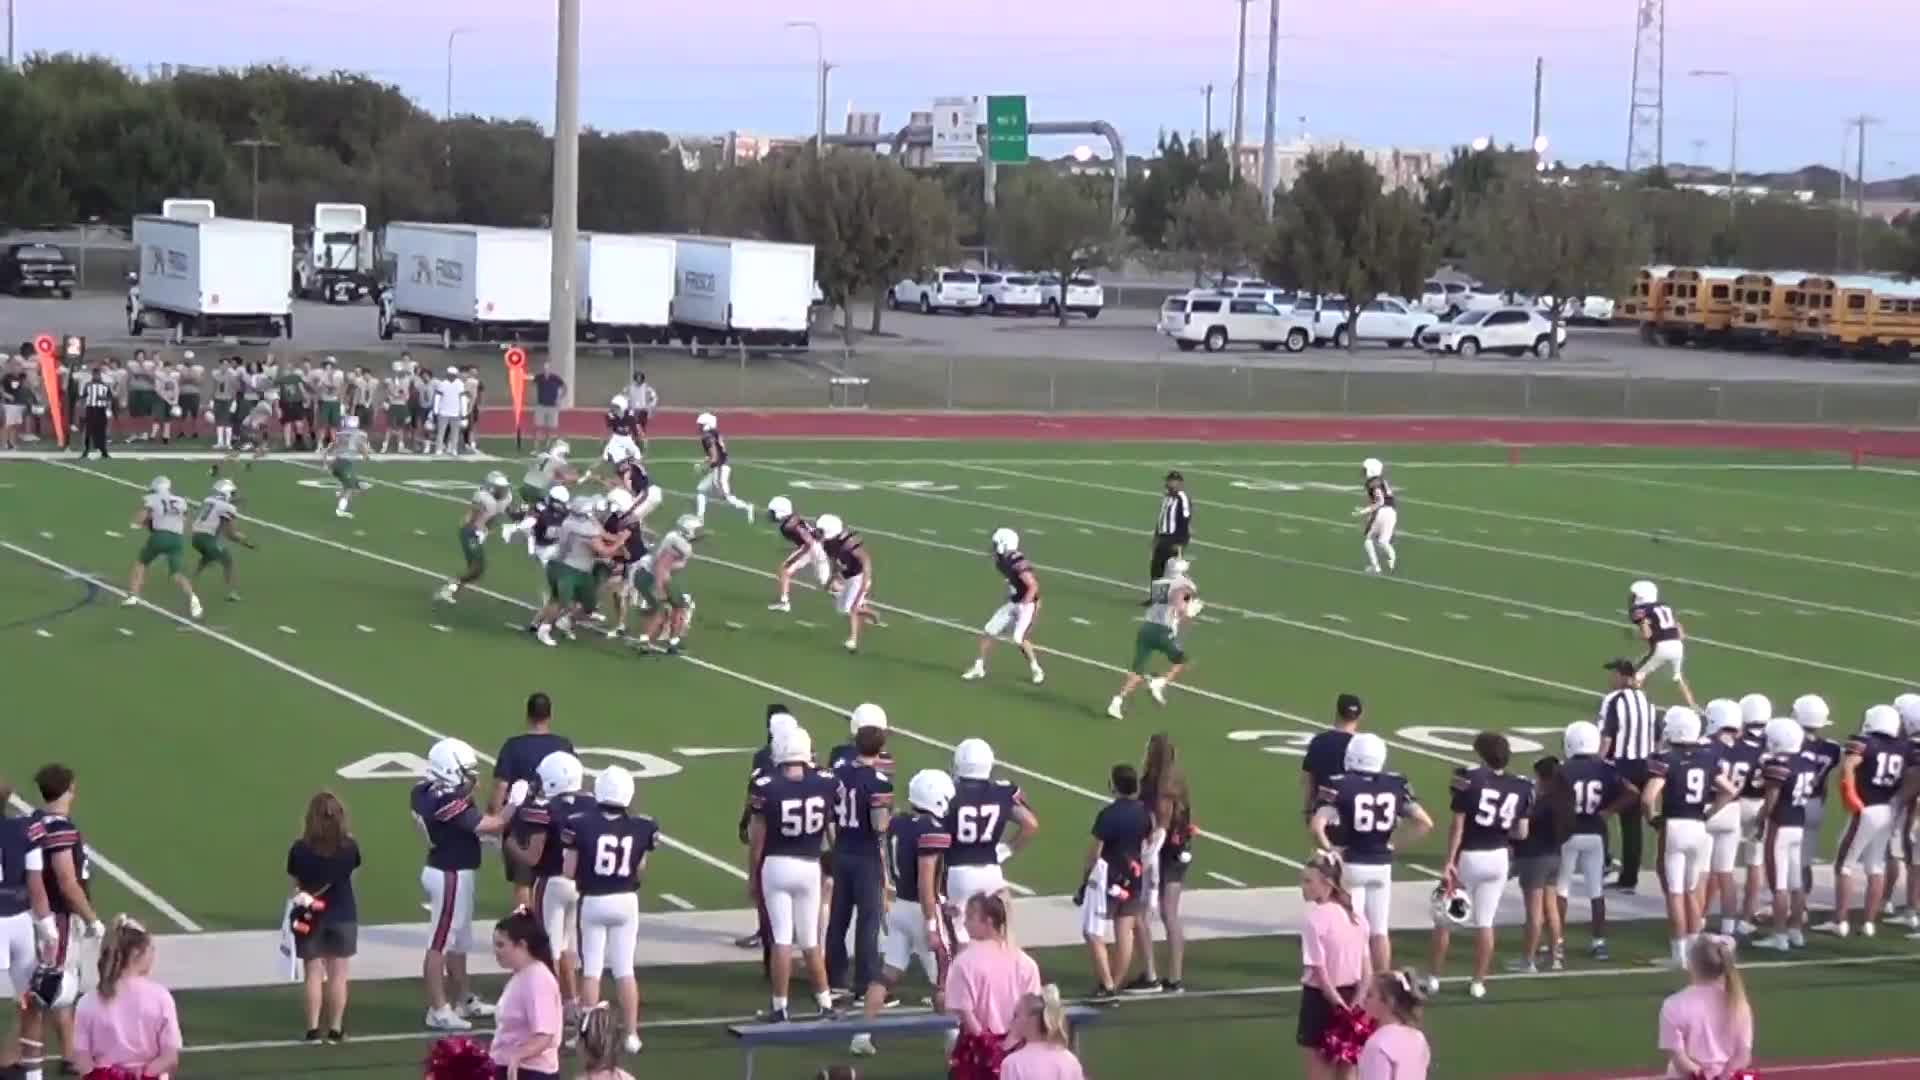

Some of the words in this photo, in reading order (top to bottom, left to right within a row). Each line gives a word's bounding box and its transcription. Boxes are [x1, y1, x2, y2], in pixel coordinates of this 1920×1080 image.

[1573, 780, 1602, 814] 16
[1685, 767, 1705, 804] 9
[780, 796, 825, 837] 56
[957, 804, 1001, 843] 67
[1354, 793, 1396, 831] 63
[1474, 788, 1519, 829] 54
[593, 835, 633, 877] 61
